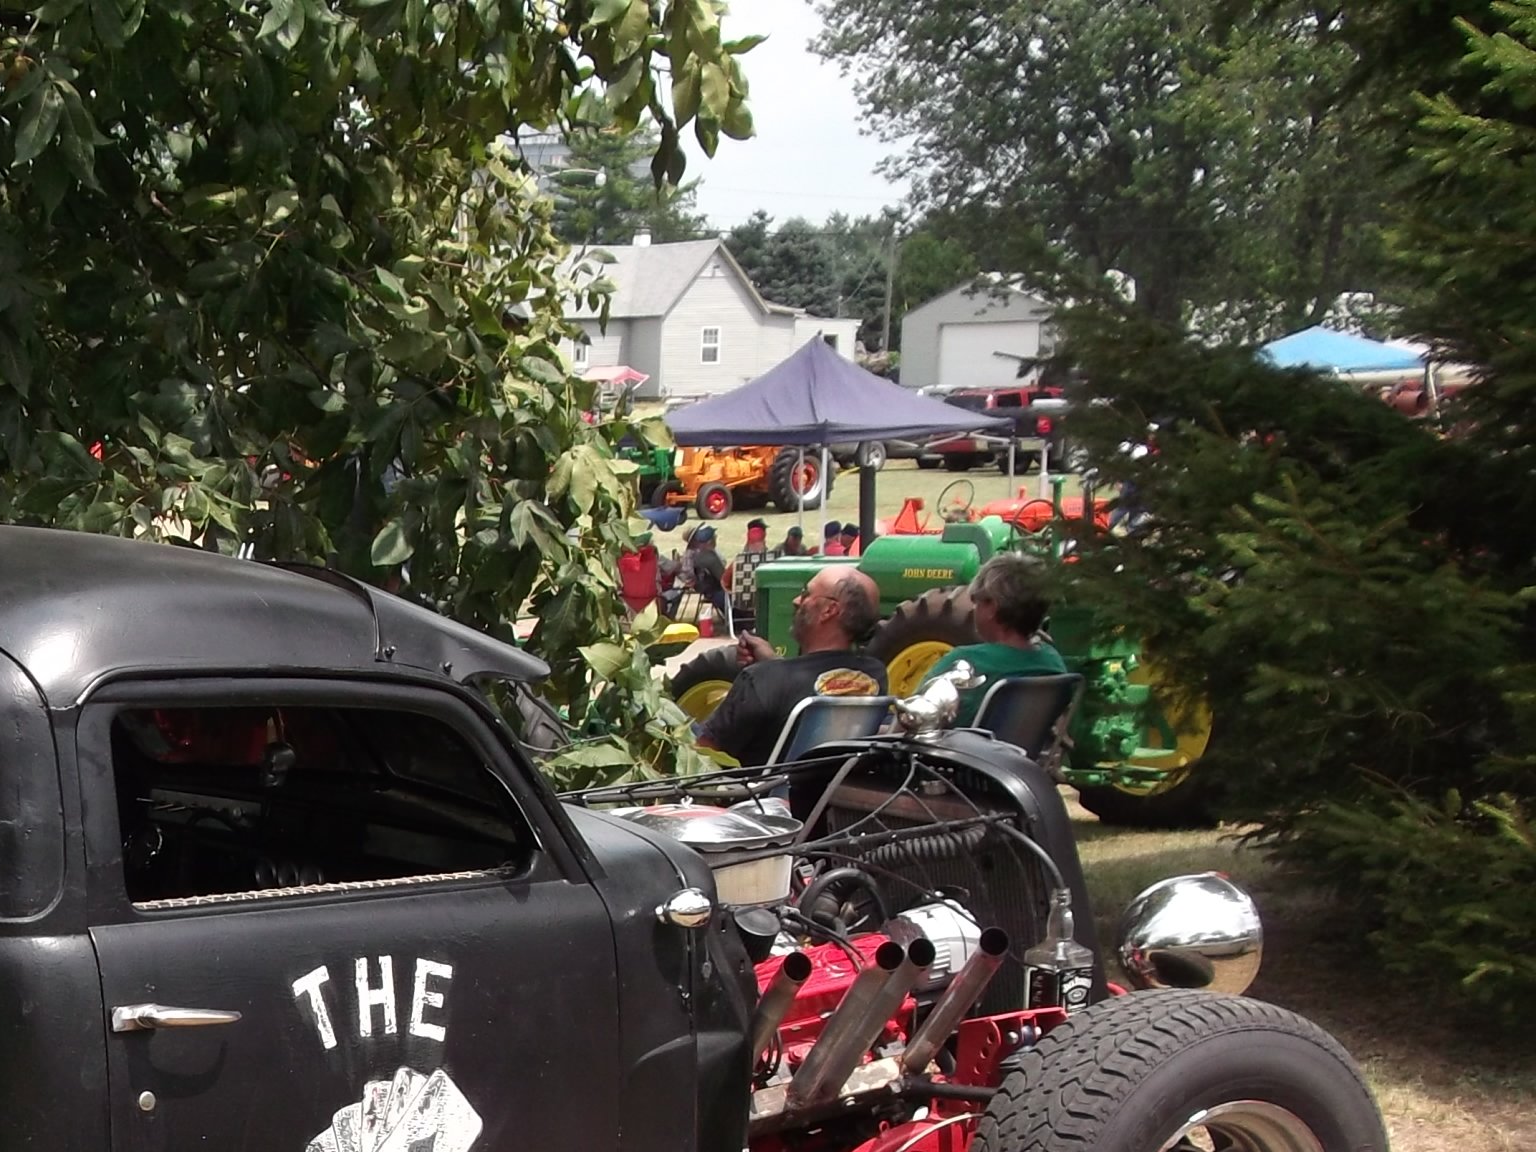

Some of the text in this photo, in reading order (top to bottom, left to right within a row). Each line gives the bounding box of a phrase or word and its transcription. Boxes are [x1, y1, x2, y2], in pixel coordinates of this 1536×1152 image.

[902, 567, 954, 579] JOHN DEERE
[292, 955, 454, 1050] THE
